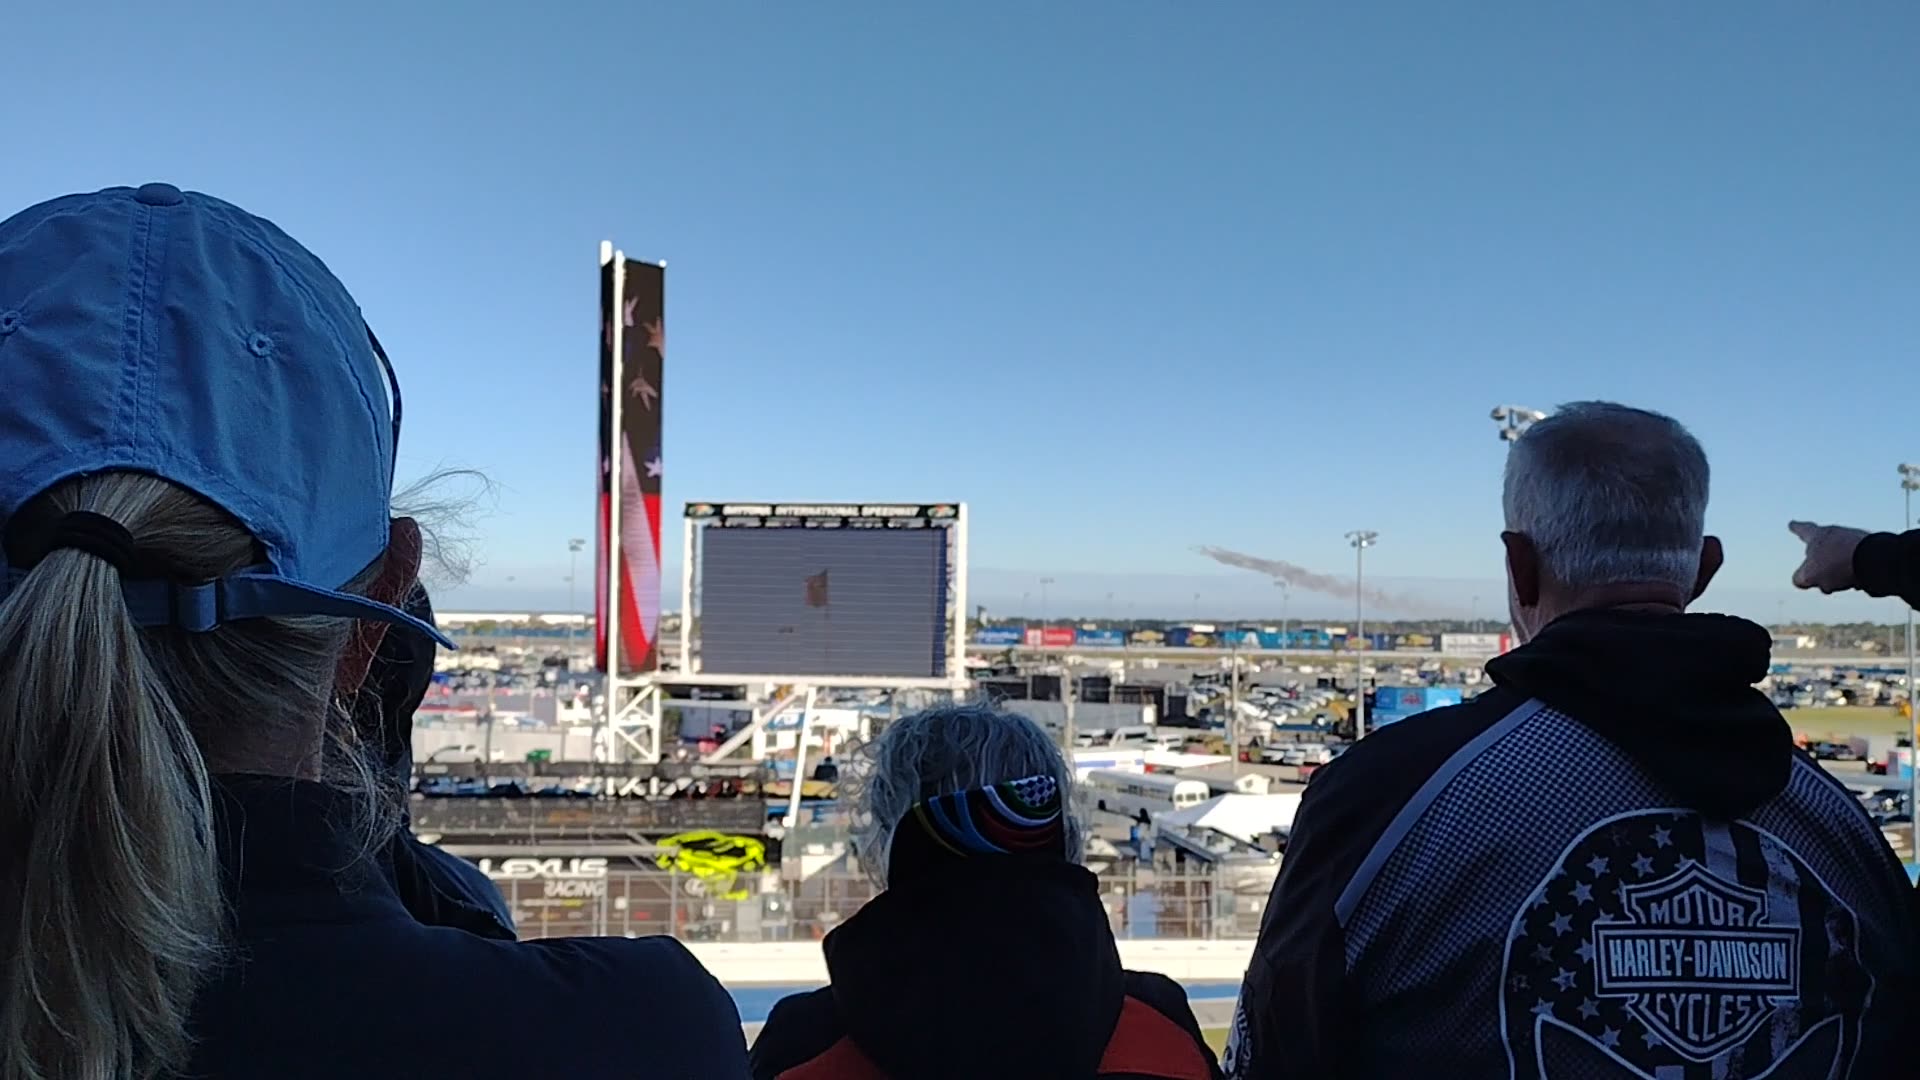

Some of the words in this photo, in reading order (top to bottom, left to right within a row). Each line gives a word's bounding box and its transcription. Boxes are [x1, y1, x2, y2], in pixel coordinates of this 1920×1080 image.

[775, 506, 858, 516] INTERNATIONAL
[862, 506, 919, 516] SPEEDWAY
[479, 858, 607, 879] LEXUS
[544, 880, 605, 897] RACING
[1651, 885, 1745, 926] MOTOR
[1608, 938, 1787, 980] HARLEY-DAVIDSON
[1655, 993, 1752, 1042] CYCLES
